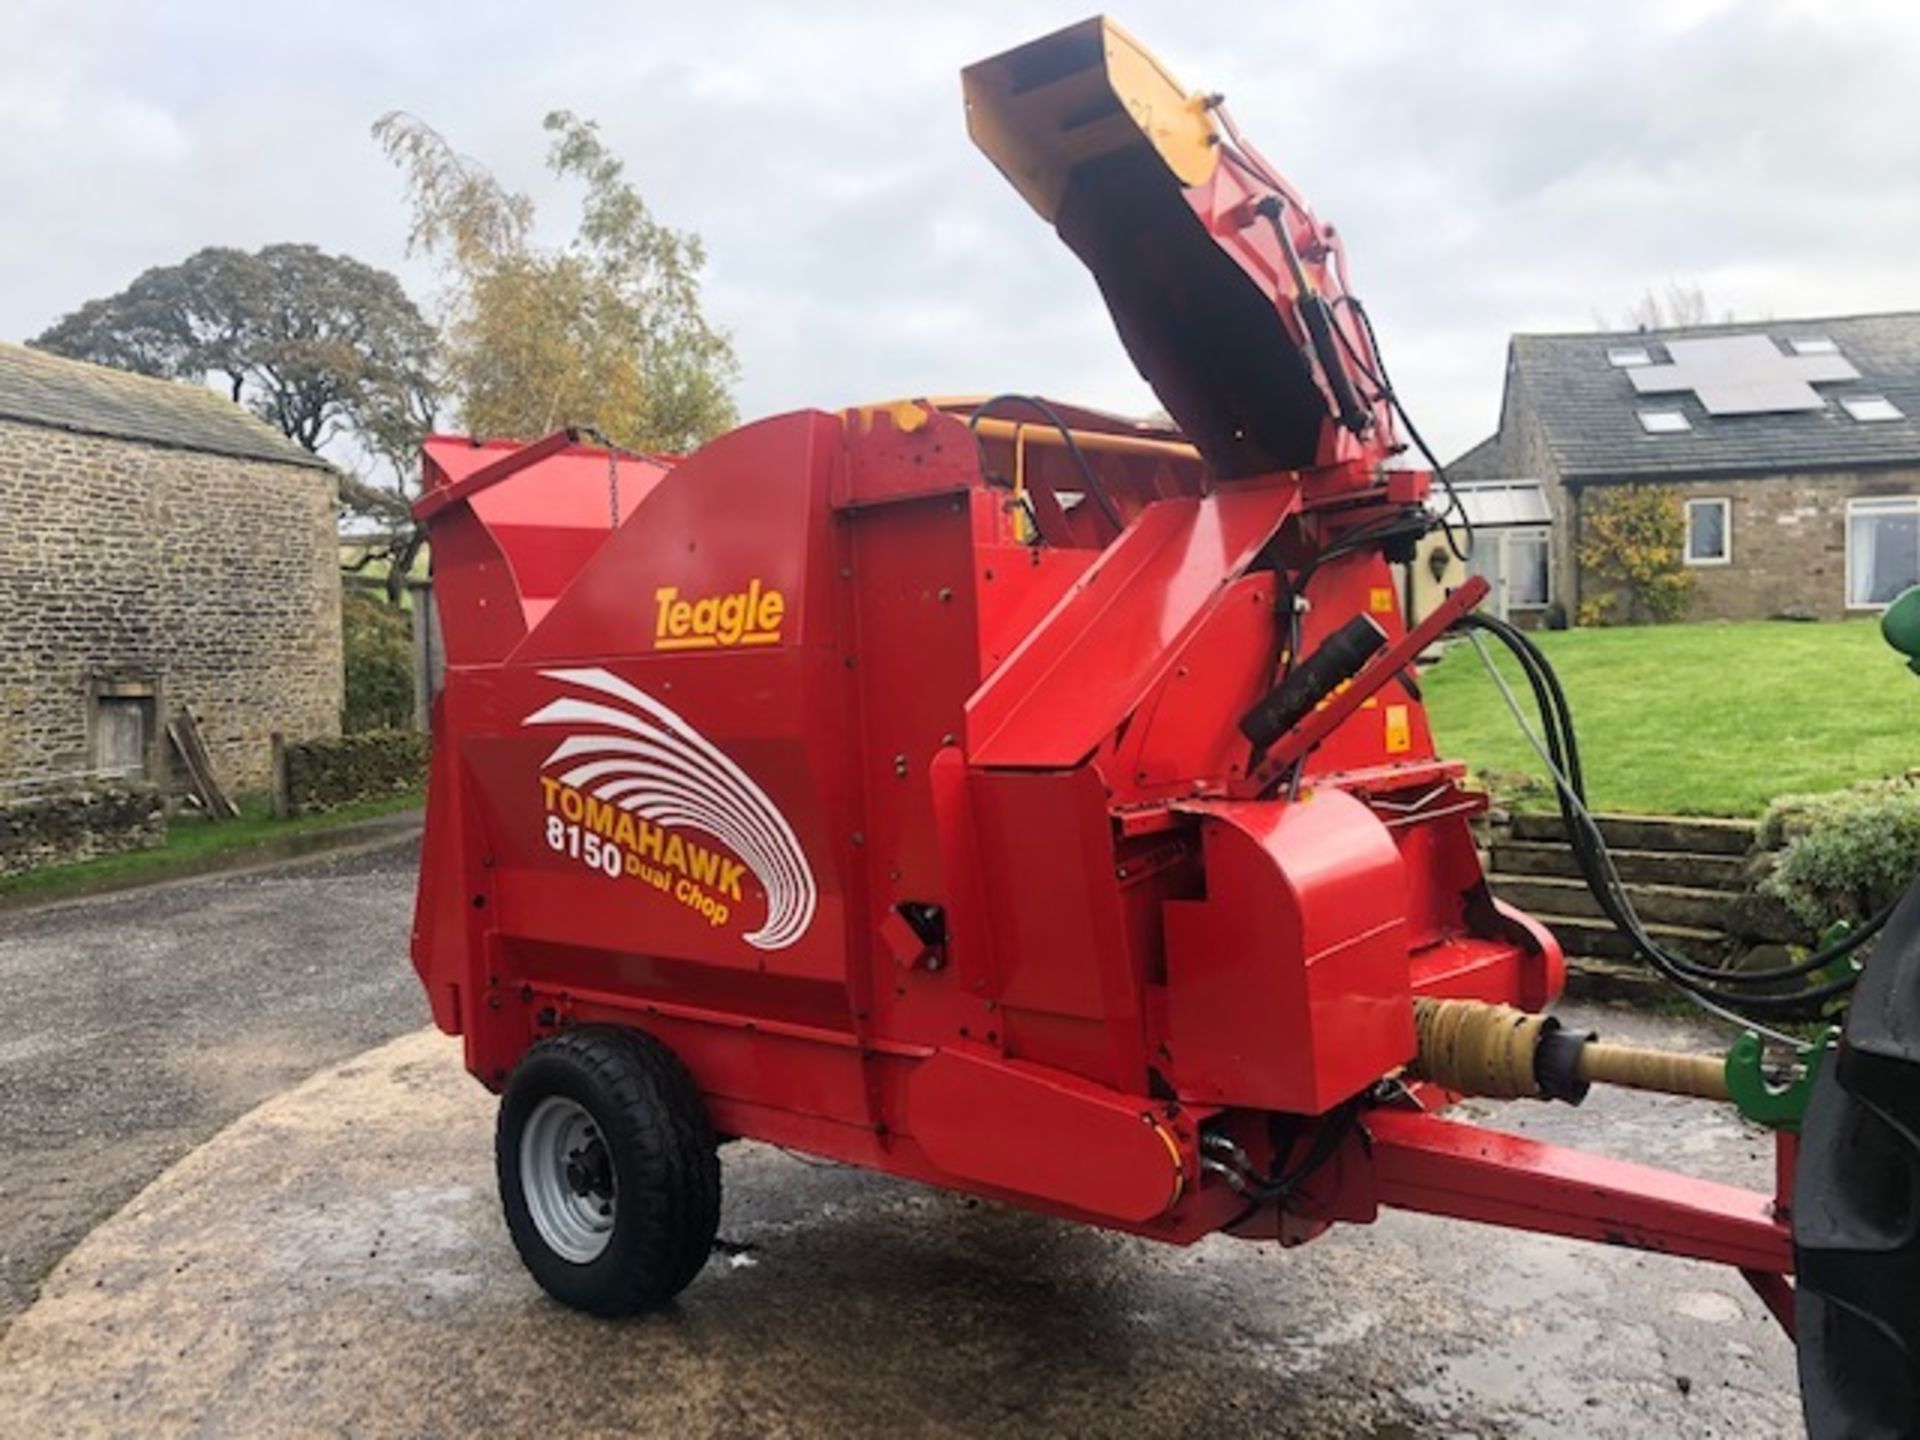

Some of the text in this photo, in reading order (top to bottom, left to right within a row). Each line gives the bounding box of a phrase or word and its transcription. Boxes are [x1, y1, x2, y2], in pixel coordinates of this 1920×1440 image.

[655, 579, 784, 649] Teagle
[541, 777, 746, 901] TOMAHAWK
[545, 816, 729, 926] 8150 Dual Chop
